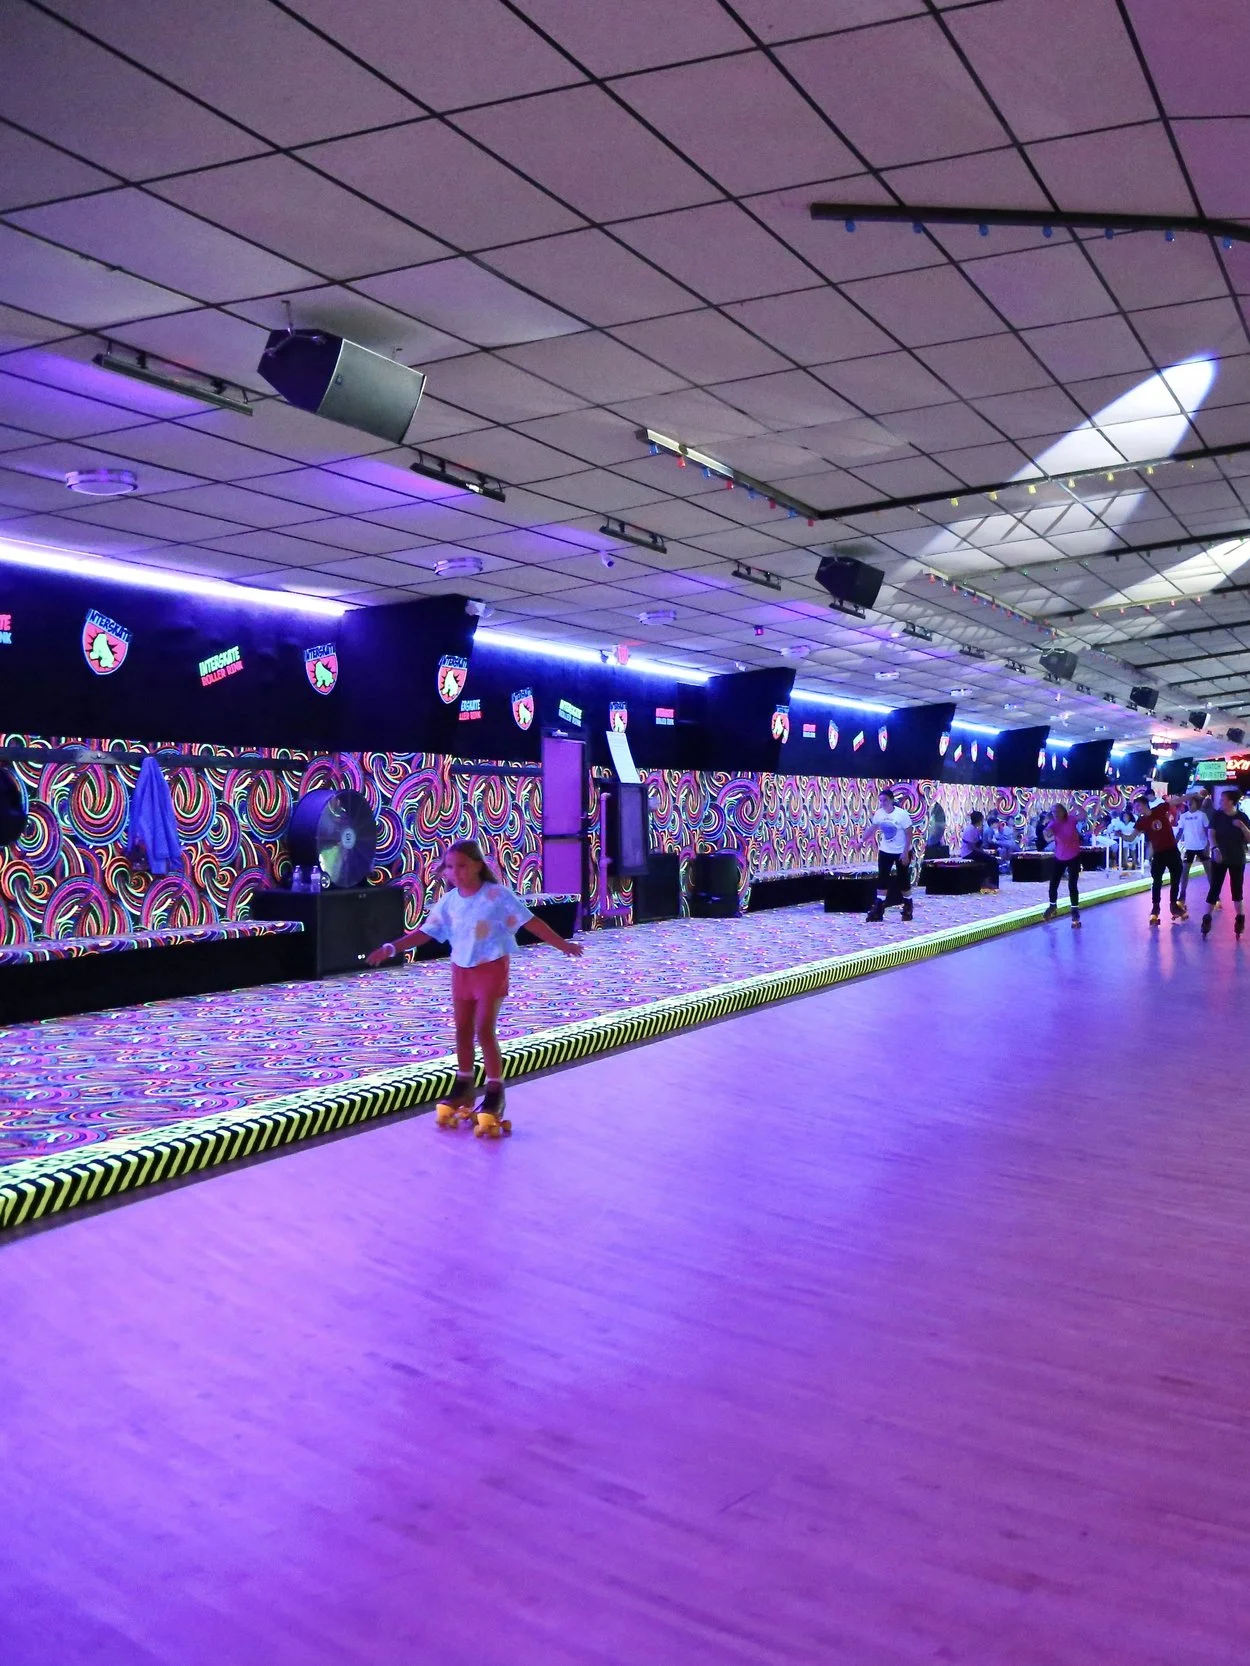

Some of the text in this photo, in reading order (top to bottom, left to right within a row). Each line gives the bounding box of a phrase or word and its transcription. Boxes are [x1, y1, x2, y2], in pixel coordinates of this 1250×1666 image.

[199, 645, 241, 677] INTERSKATE
[201, 660, 244, 687] ROLLER RINK
